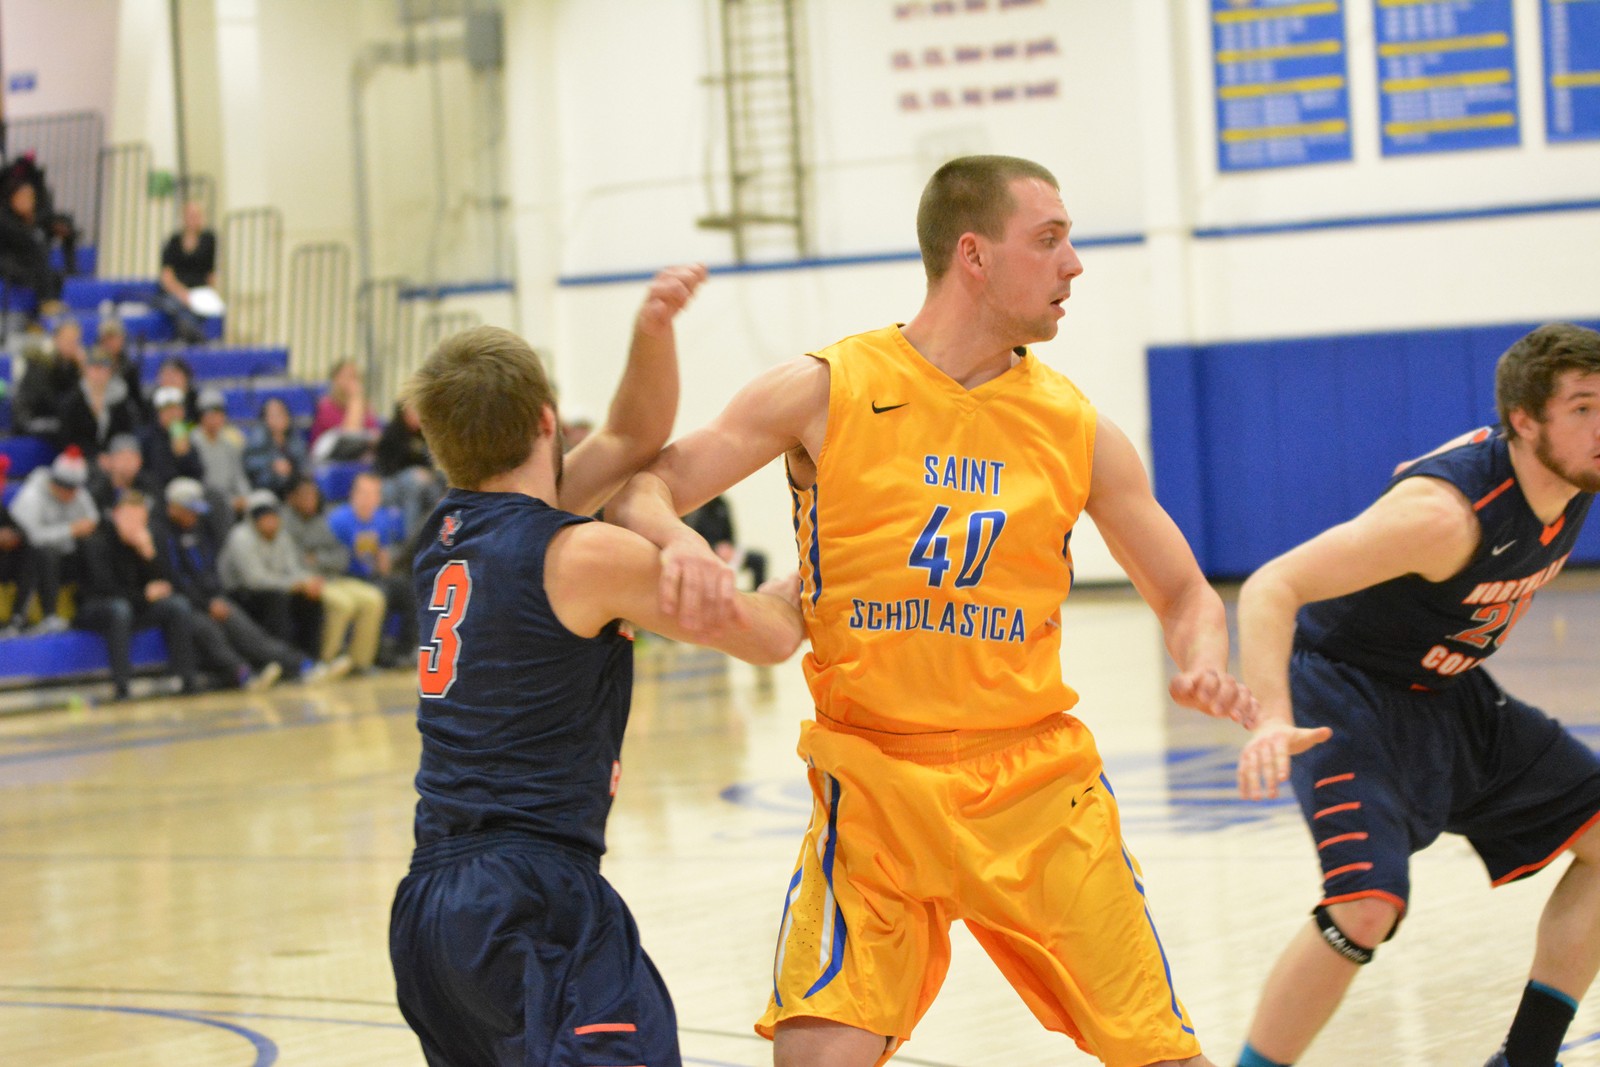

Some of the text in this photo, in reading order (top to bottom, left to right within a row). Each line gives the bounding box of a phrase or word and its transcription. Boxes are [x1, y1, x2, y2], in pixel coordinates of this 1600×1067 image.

[924, 455, 1005, 496] SAINT
[907, 504, 1007, 588] 40
[417, 560, 472, 698] 3
[849, 598, 1026, 643] SCHOLASICA
